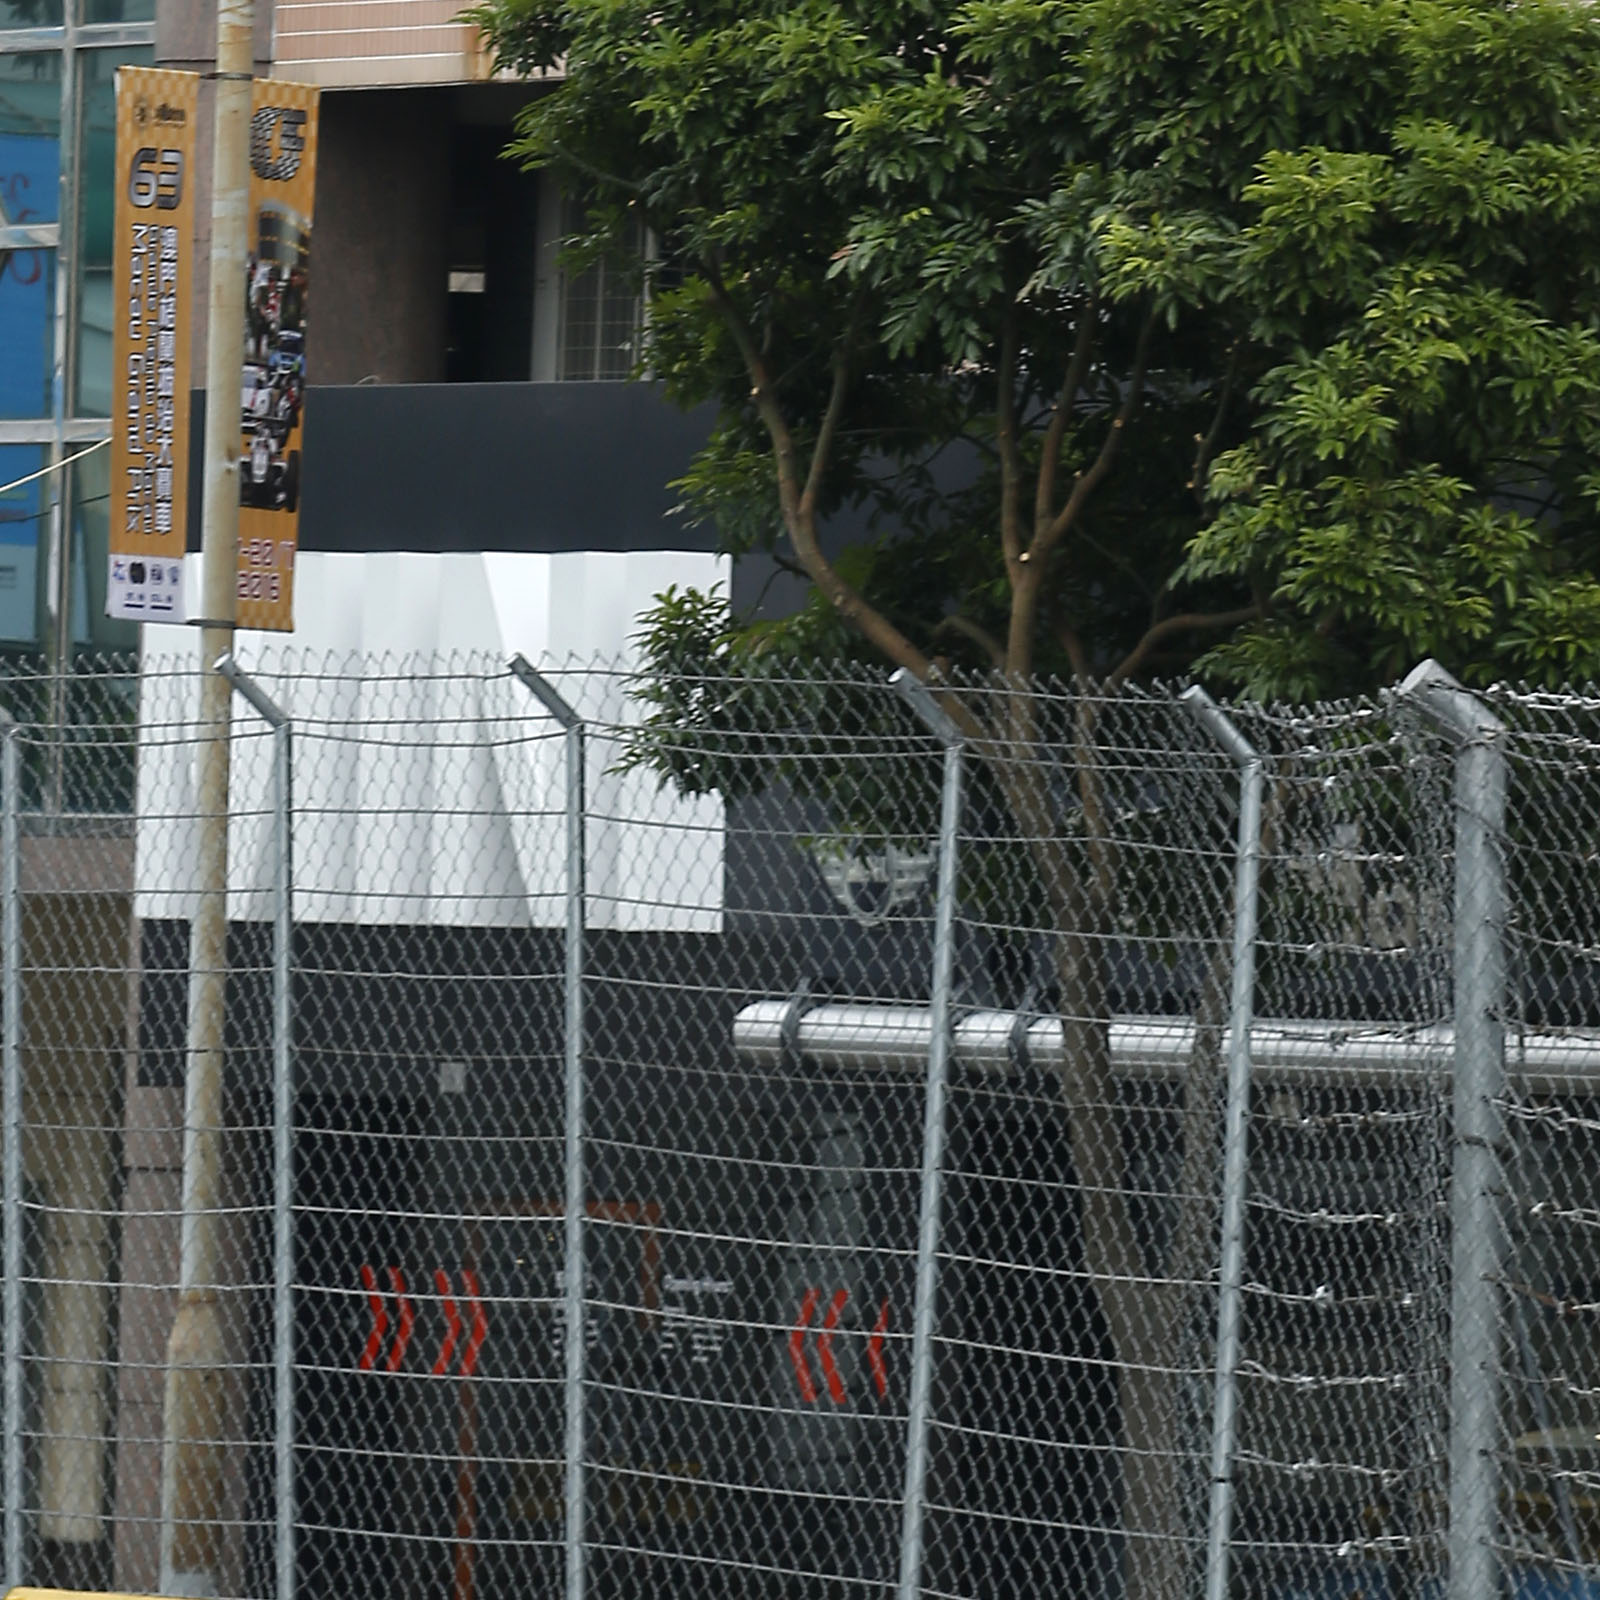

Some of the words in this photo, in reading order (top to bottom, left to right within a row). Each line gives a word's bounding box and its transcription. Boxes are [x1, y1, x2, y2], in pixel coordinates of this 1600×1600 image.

[129, 147, 184, 210] 63
[128, 223, 149, 340] Macau
[127, 353, 146, 454] Grand
[125, 467, 144, 533] Prix
